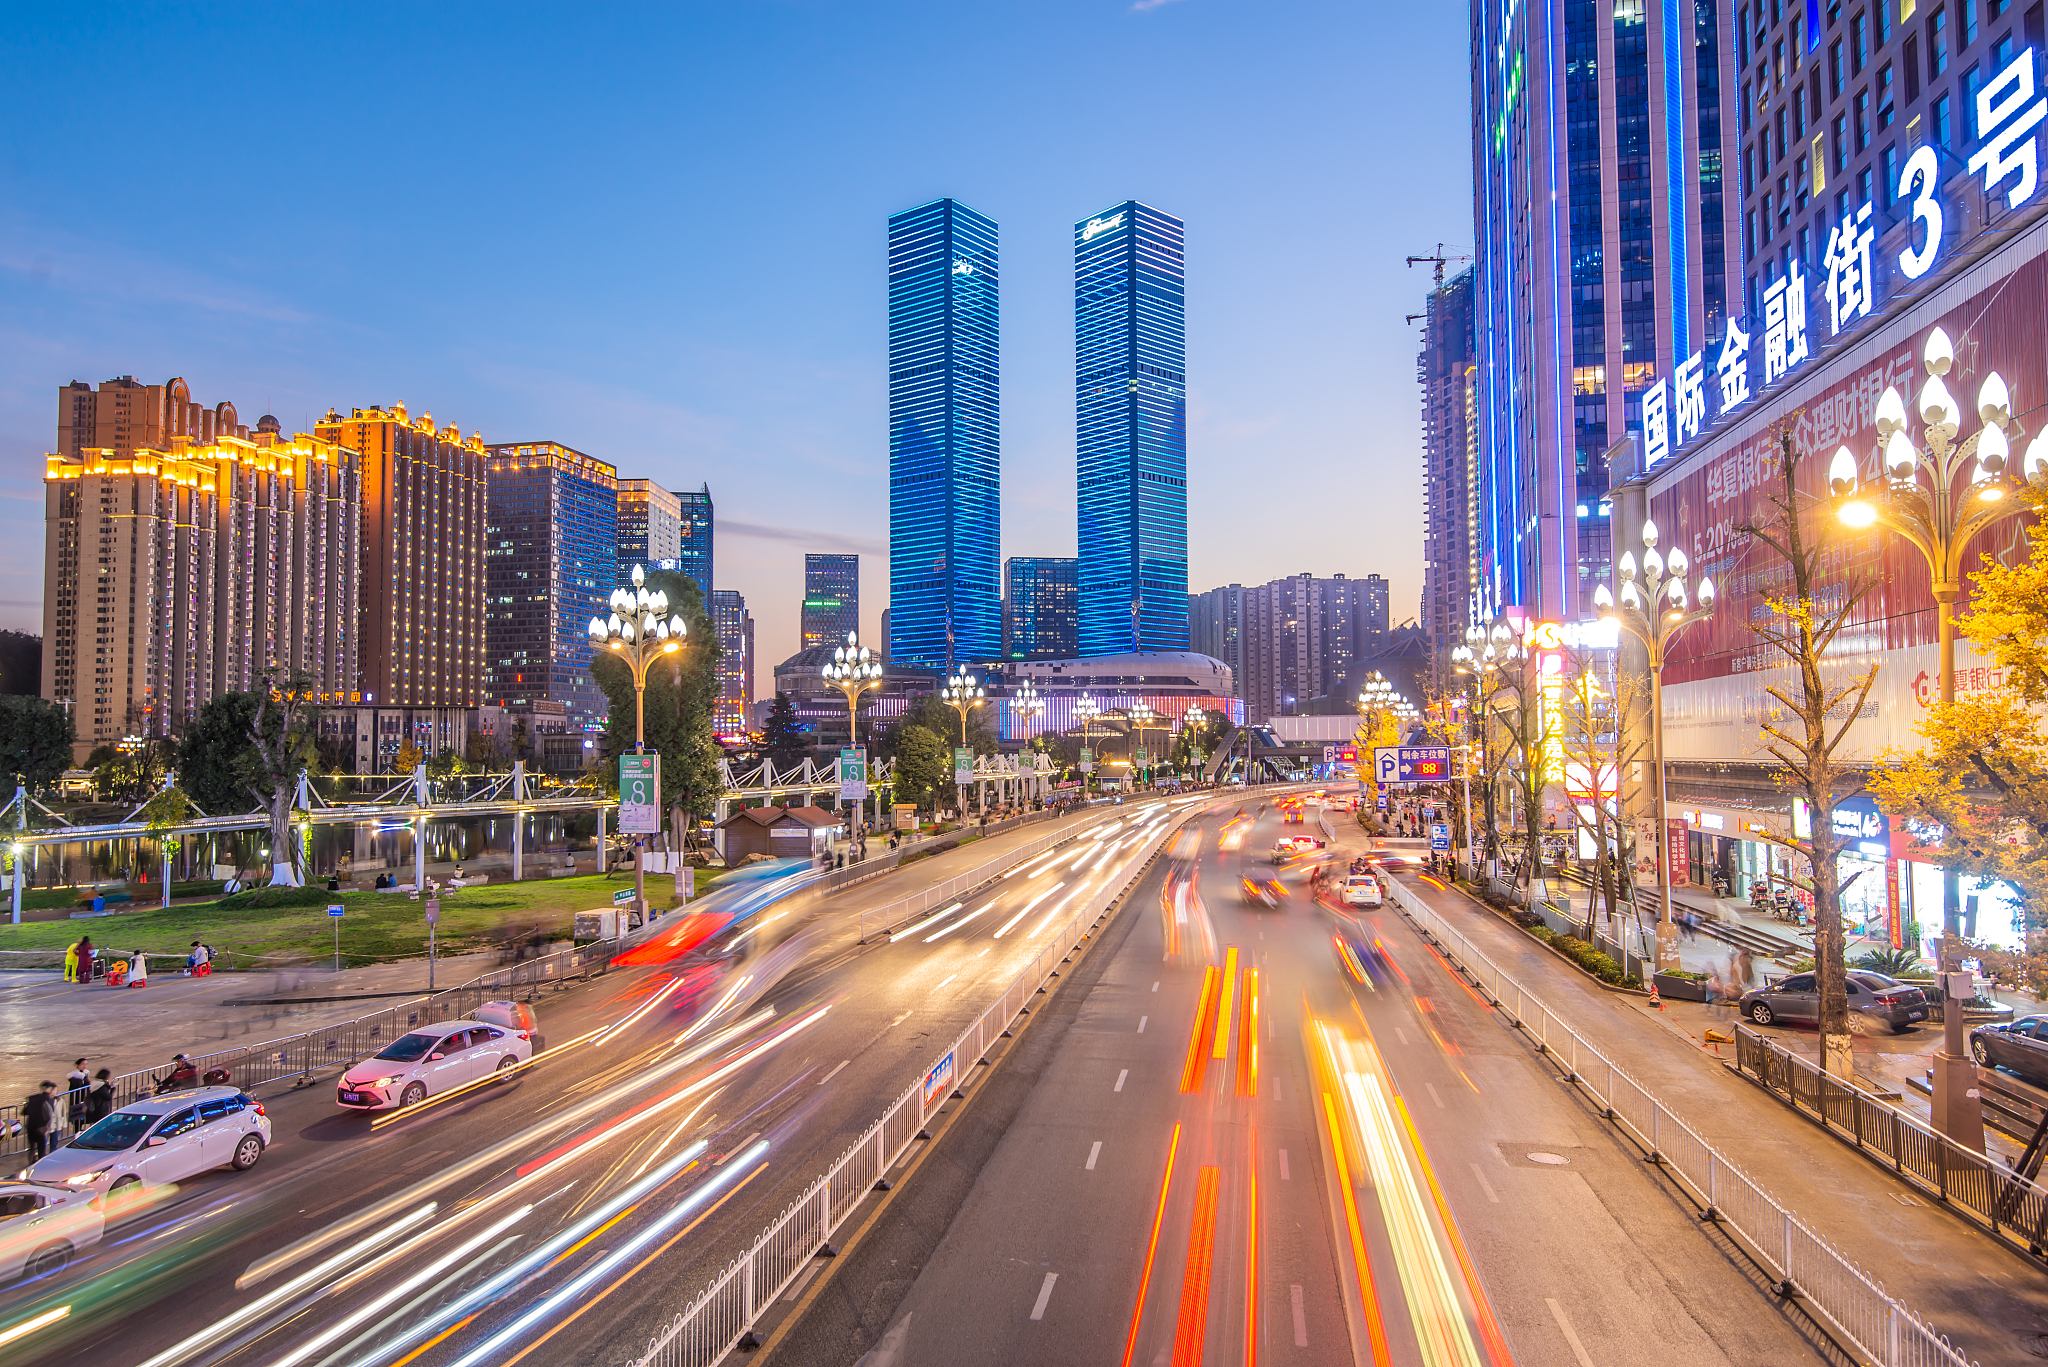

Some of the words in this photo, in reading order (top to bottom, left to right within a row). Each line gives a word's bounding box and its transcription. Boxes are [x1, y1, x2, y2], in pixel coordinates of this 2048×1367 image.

[1642, 46, 2048, 470] 国际金融街3号
[1402, 749, 1447, 760] 剩余车位数
[849, 765, 859, 781] 8
[960, 760, 969, 771] 8
[1382, 760, 1396, 779] P
[1422, 763, 1437, 774] 88
[630, 780, 646, 807] 8
